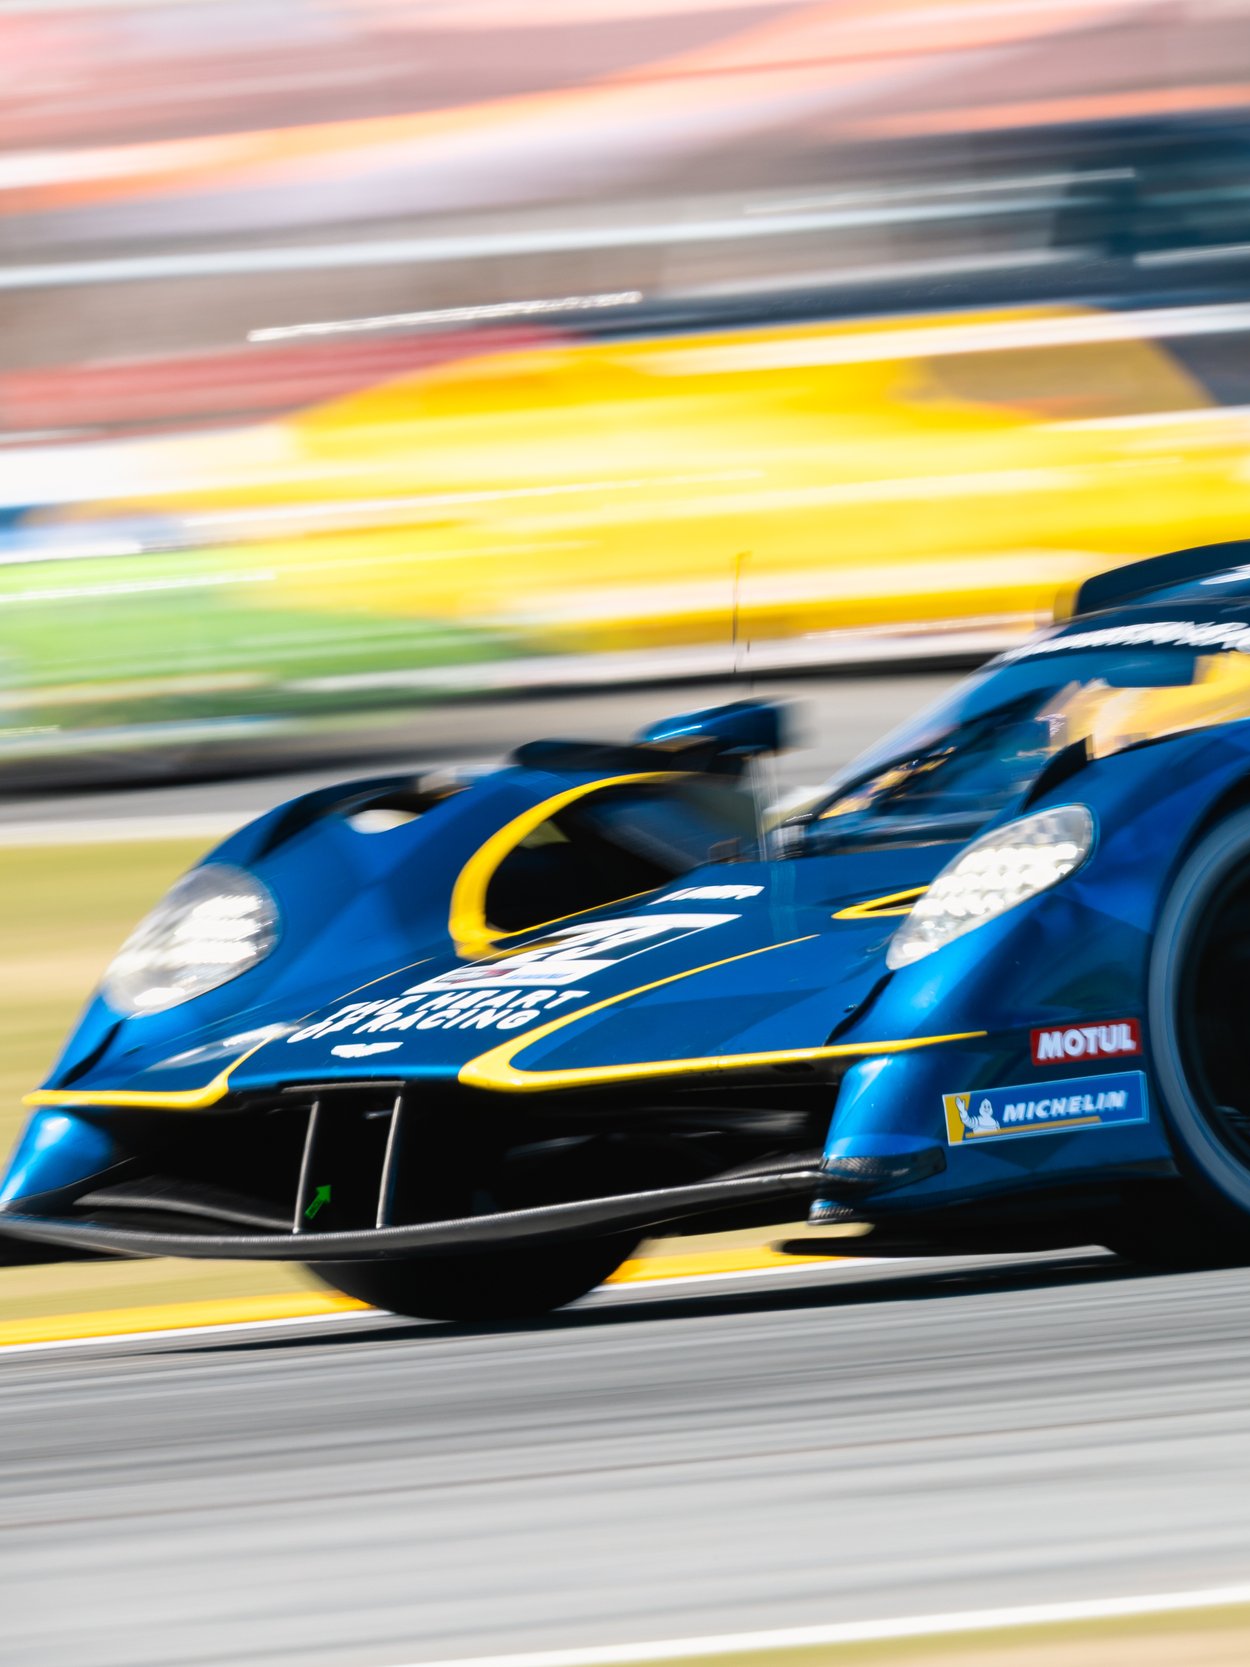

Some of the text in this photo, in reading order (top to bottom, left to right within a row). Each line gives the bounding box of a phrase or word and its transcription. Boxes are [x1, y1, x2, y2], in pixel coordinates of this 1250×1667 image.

[325, 989, 590, 1021] THE HEART
[286, 1008, 541, 1043] OF RACING
[1037, 1024, 1136, 1060] MOTUL
[1004, 1091, 1128, 1122] MICHELIN
